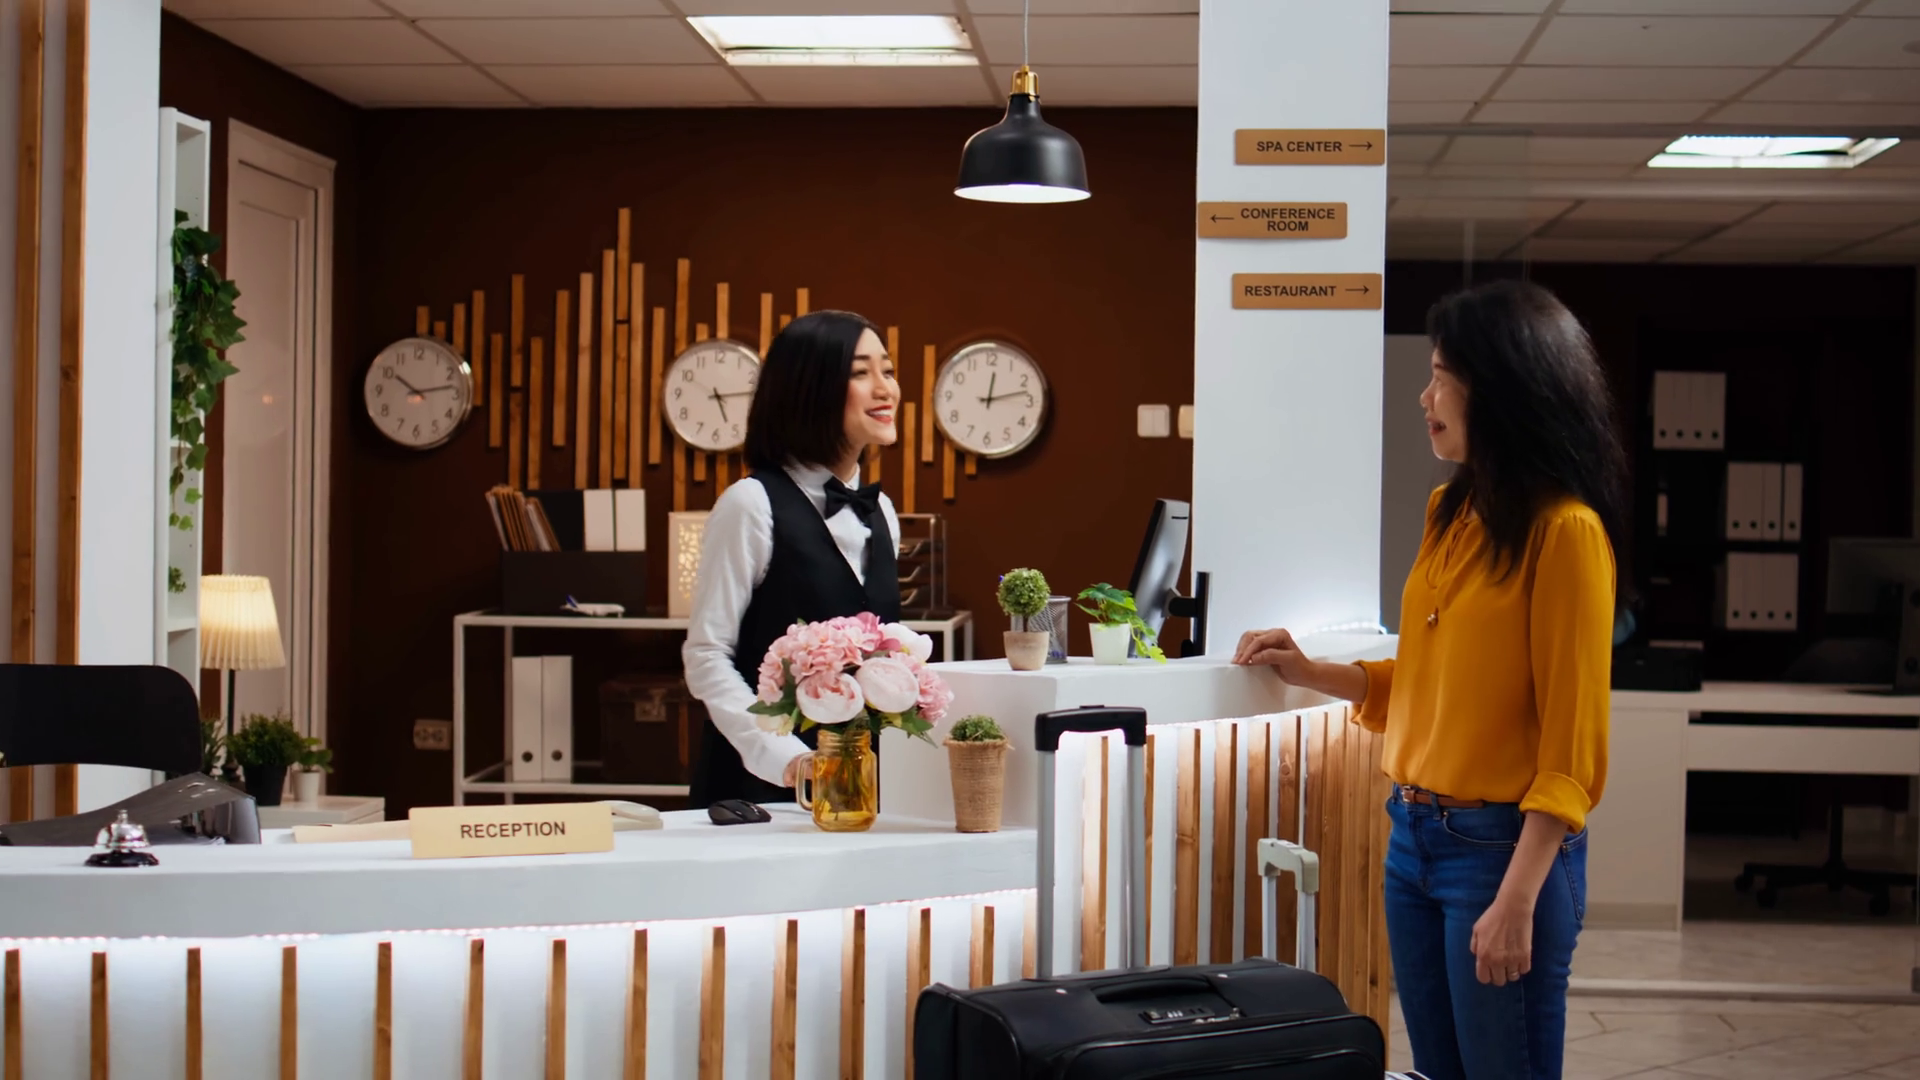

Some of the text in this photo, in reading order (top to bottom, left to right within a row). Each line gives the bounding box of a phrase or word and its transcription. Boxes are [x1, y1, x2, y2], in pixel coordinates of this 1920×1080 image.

[1256, 141, 1342, 152] SPA CENTER
[1240, 208, 1336, 219] CONFERENCE
[1267, 220, 1309, 232] ROOM
[1244, 285, 1337, 297] RESTAURANT
[396, 353, 405, 366] 11
[414, 347, 425, 361] 12
[714, 350, 726, 364] 12
[986, 352, 998, 366] 12
[696, 356, 705, 369] 11
[967, 360, 976, 372] 11
[382, 366, 394, 379] 10
[446, 367, 454, 381] 2
[682, 369, 694, 383] 10
[748, 370, 757, 385] 2
[953, 371, 965, 385] 10
[1020, 373, 1029, 388] 2
[375, 384, 383, 398] 9
[451, 386, 460, 401] 3
[674, 387, 682, 400] 9
[944, 390, 953, 402] 9
[1025, 394, 1034, 409] 3
[380, 403, 389, 417] 8
[444, 407, 453, 420] 4
[679, 407, 688, 421] 8
[949, 409, 959, 424] 8
[397, 417, 405, 431] 7
[431, 420, 439, 434] 5
[1017, 415, 1026, 427] 4
[412, 424, 420, 439] 6
[696, 422, 704, 435] 7
[711, 428, 720, 443] 6
[731, 424, 739, 438] 5
[967, 424, 975, 438] 7
[1002, 426, 1011, 441] 5
[982, 431, 991, 447] 6
[460, 821, 567, 839] RECEPTION
